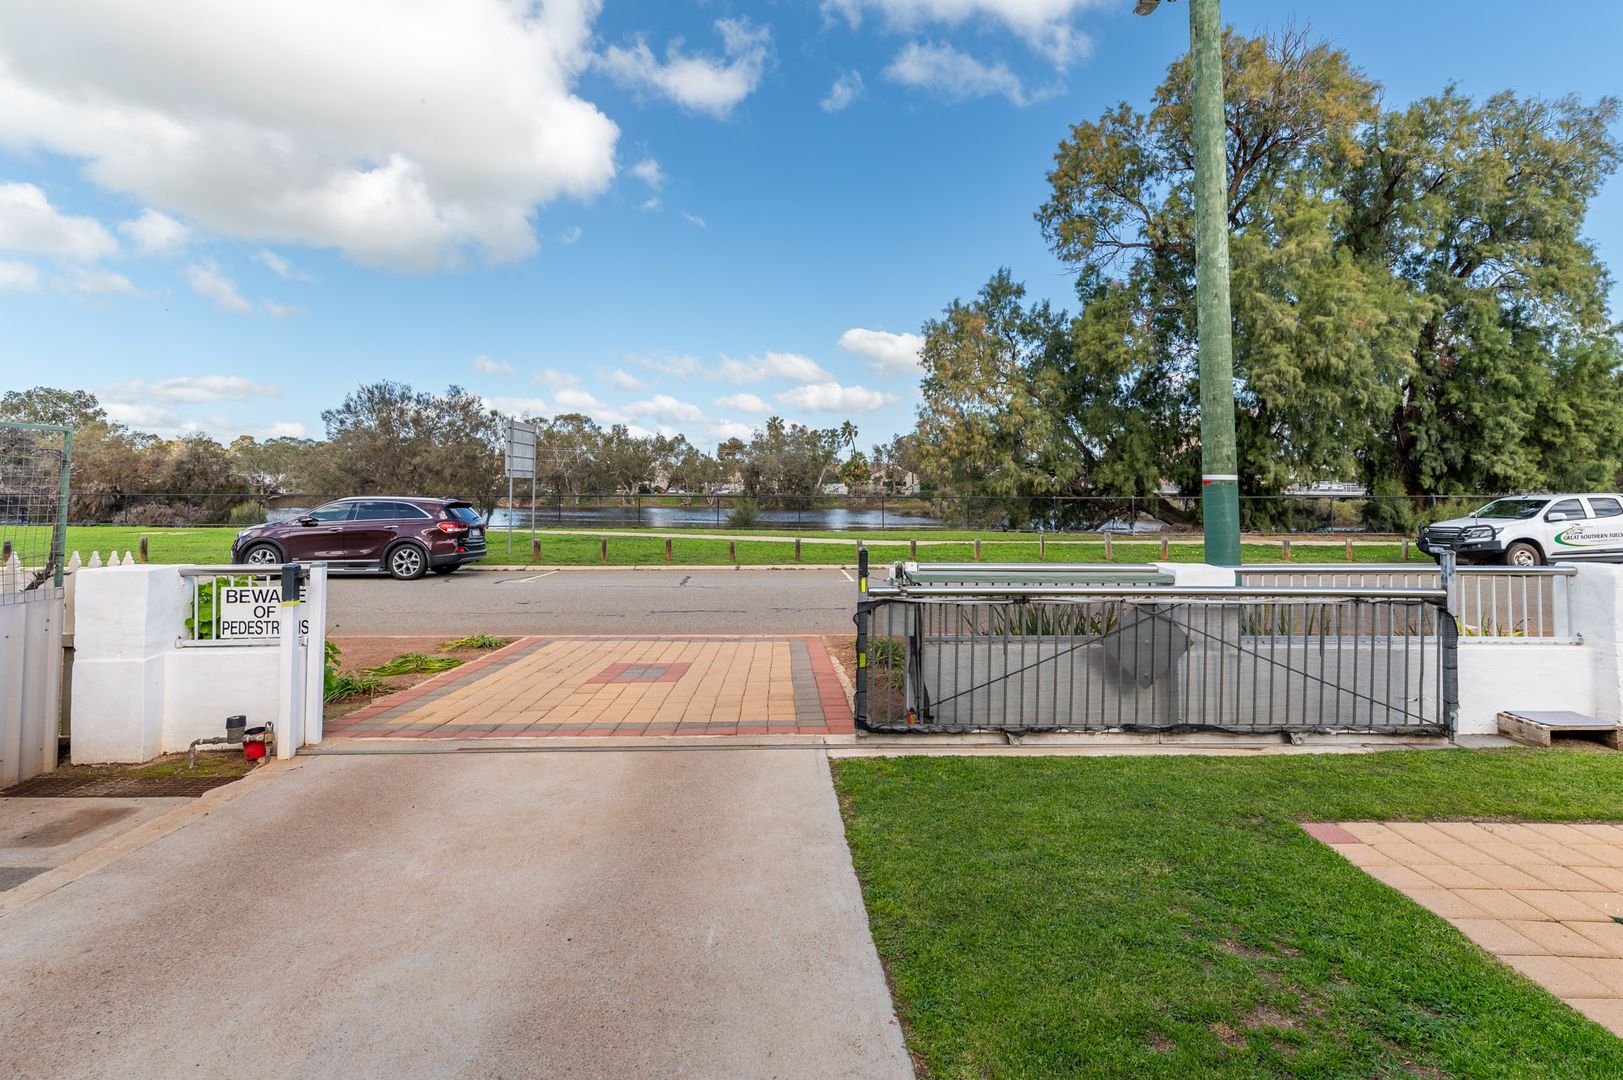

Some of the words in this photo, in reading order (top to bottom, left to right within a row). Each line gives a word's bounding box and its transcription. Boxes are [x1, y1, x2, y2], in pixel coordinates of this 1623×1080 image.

[226, 589, 307, 604] BEWAE
[253, 605, 277, 619] OF
[222, 619, 309, 635] PEDESTRS
